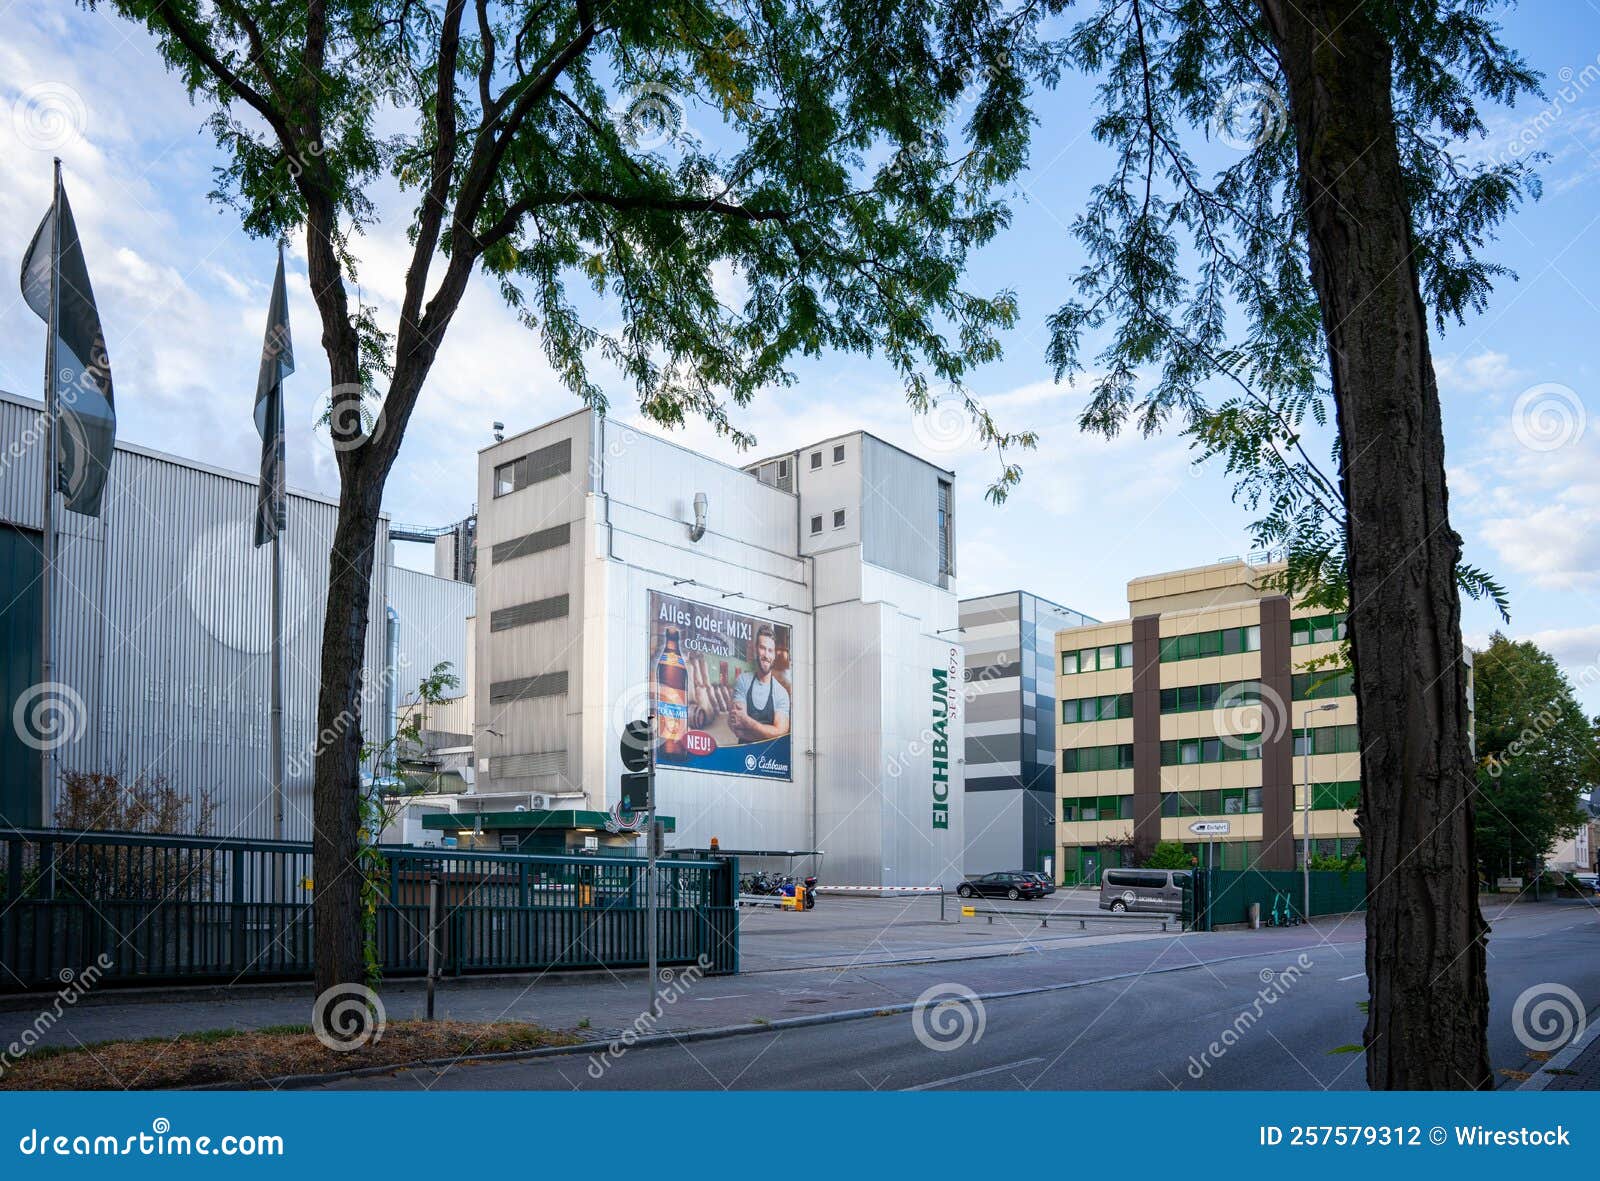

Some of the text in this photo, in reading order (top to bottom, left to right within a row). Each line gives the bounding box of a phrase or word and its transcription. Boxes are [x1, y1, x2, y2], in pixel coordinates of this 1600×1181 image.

[659, 602, 691, 627] Alles
[695, 613, 723, 633] oder
[726, 619, 752, 641] MIX!
[686, 734, 711, 752] NEU!
[932, 668, 949, 830] EICHBAUM
